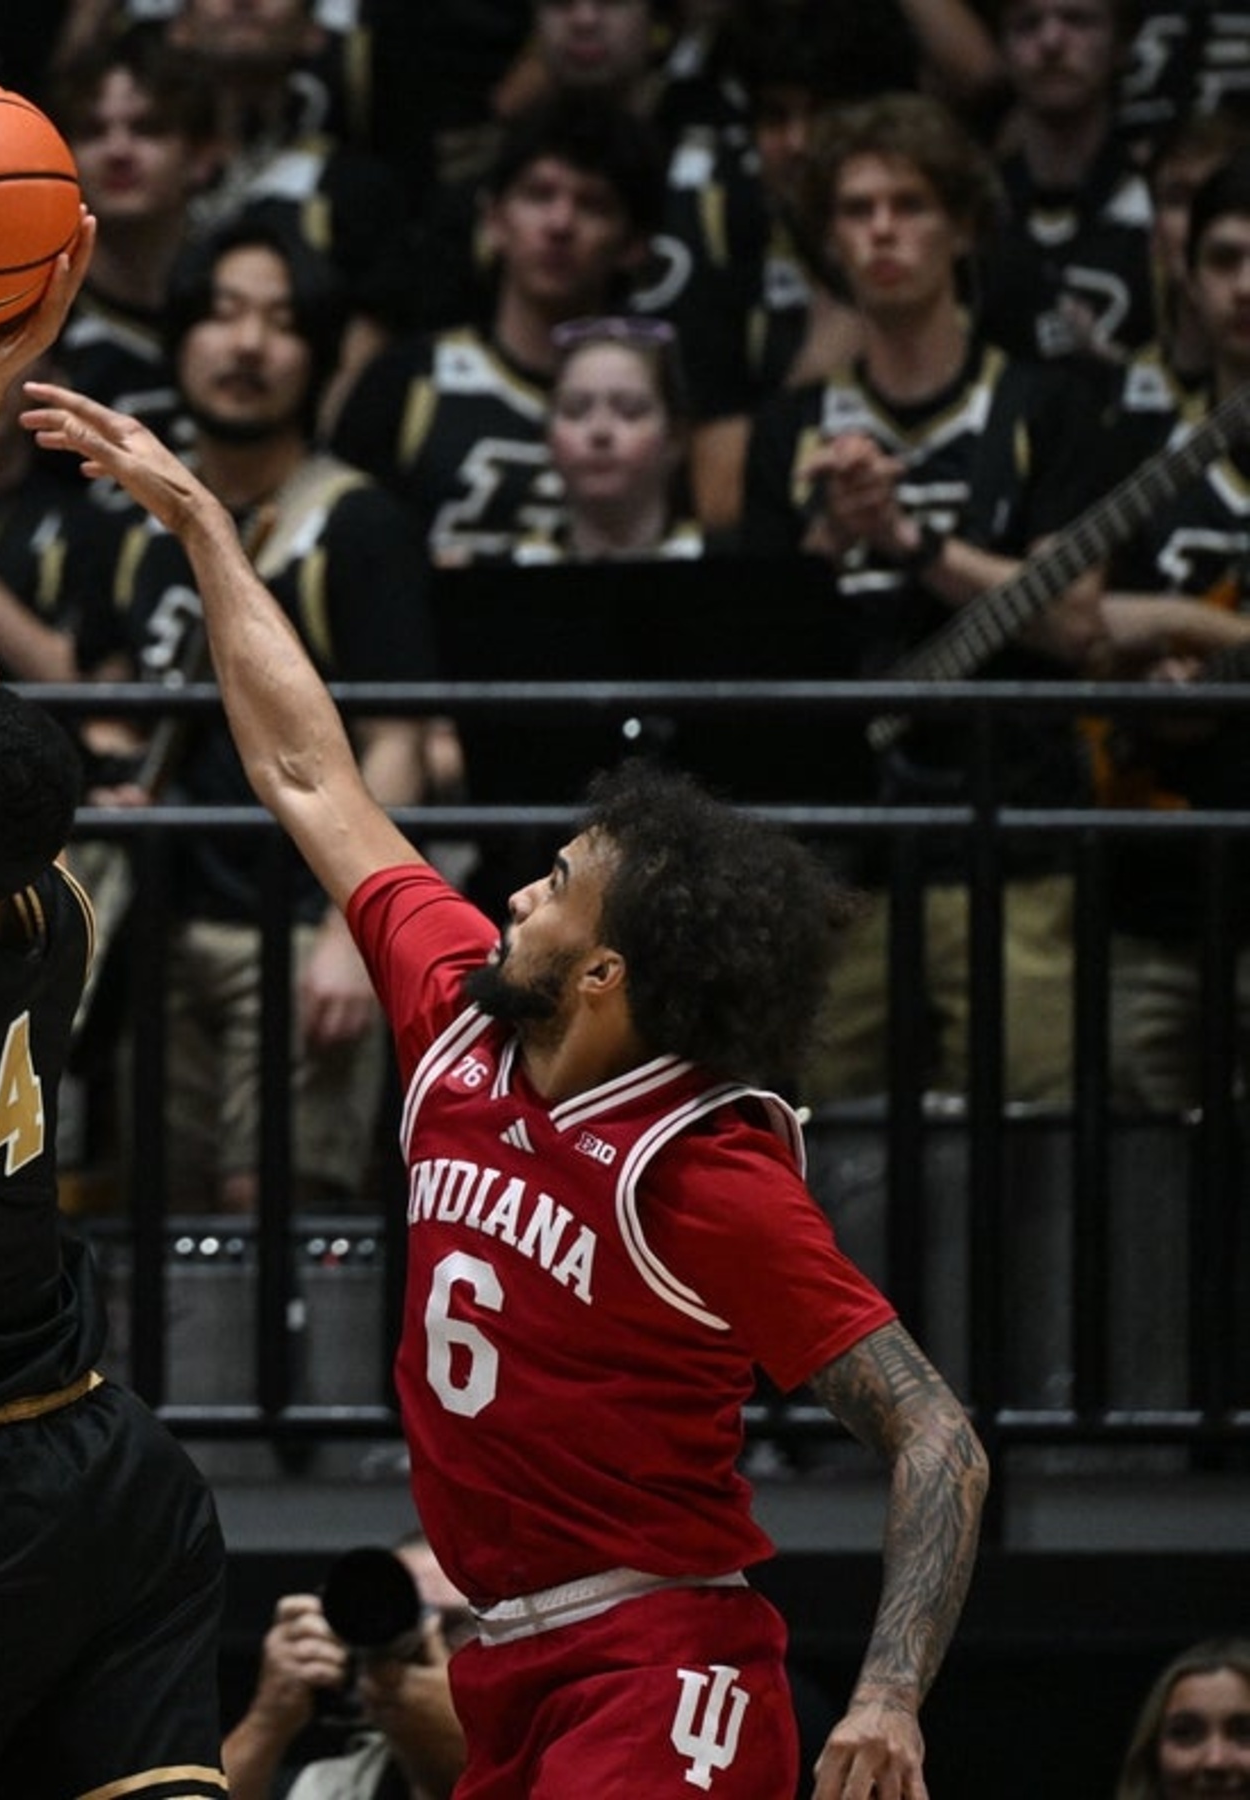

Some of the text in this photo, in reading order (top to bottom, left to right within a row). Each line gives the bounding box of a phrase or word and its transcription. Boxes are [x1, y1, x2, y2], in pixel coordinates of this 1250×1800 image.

[451, 1055, 489, 1088] 76
[407, 1158, 597, 1305] INDIANA
[425, 1250, 504, 1418] 6
